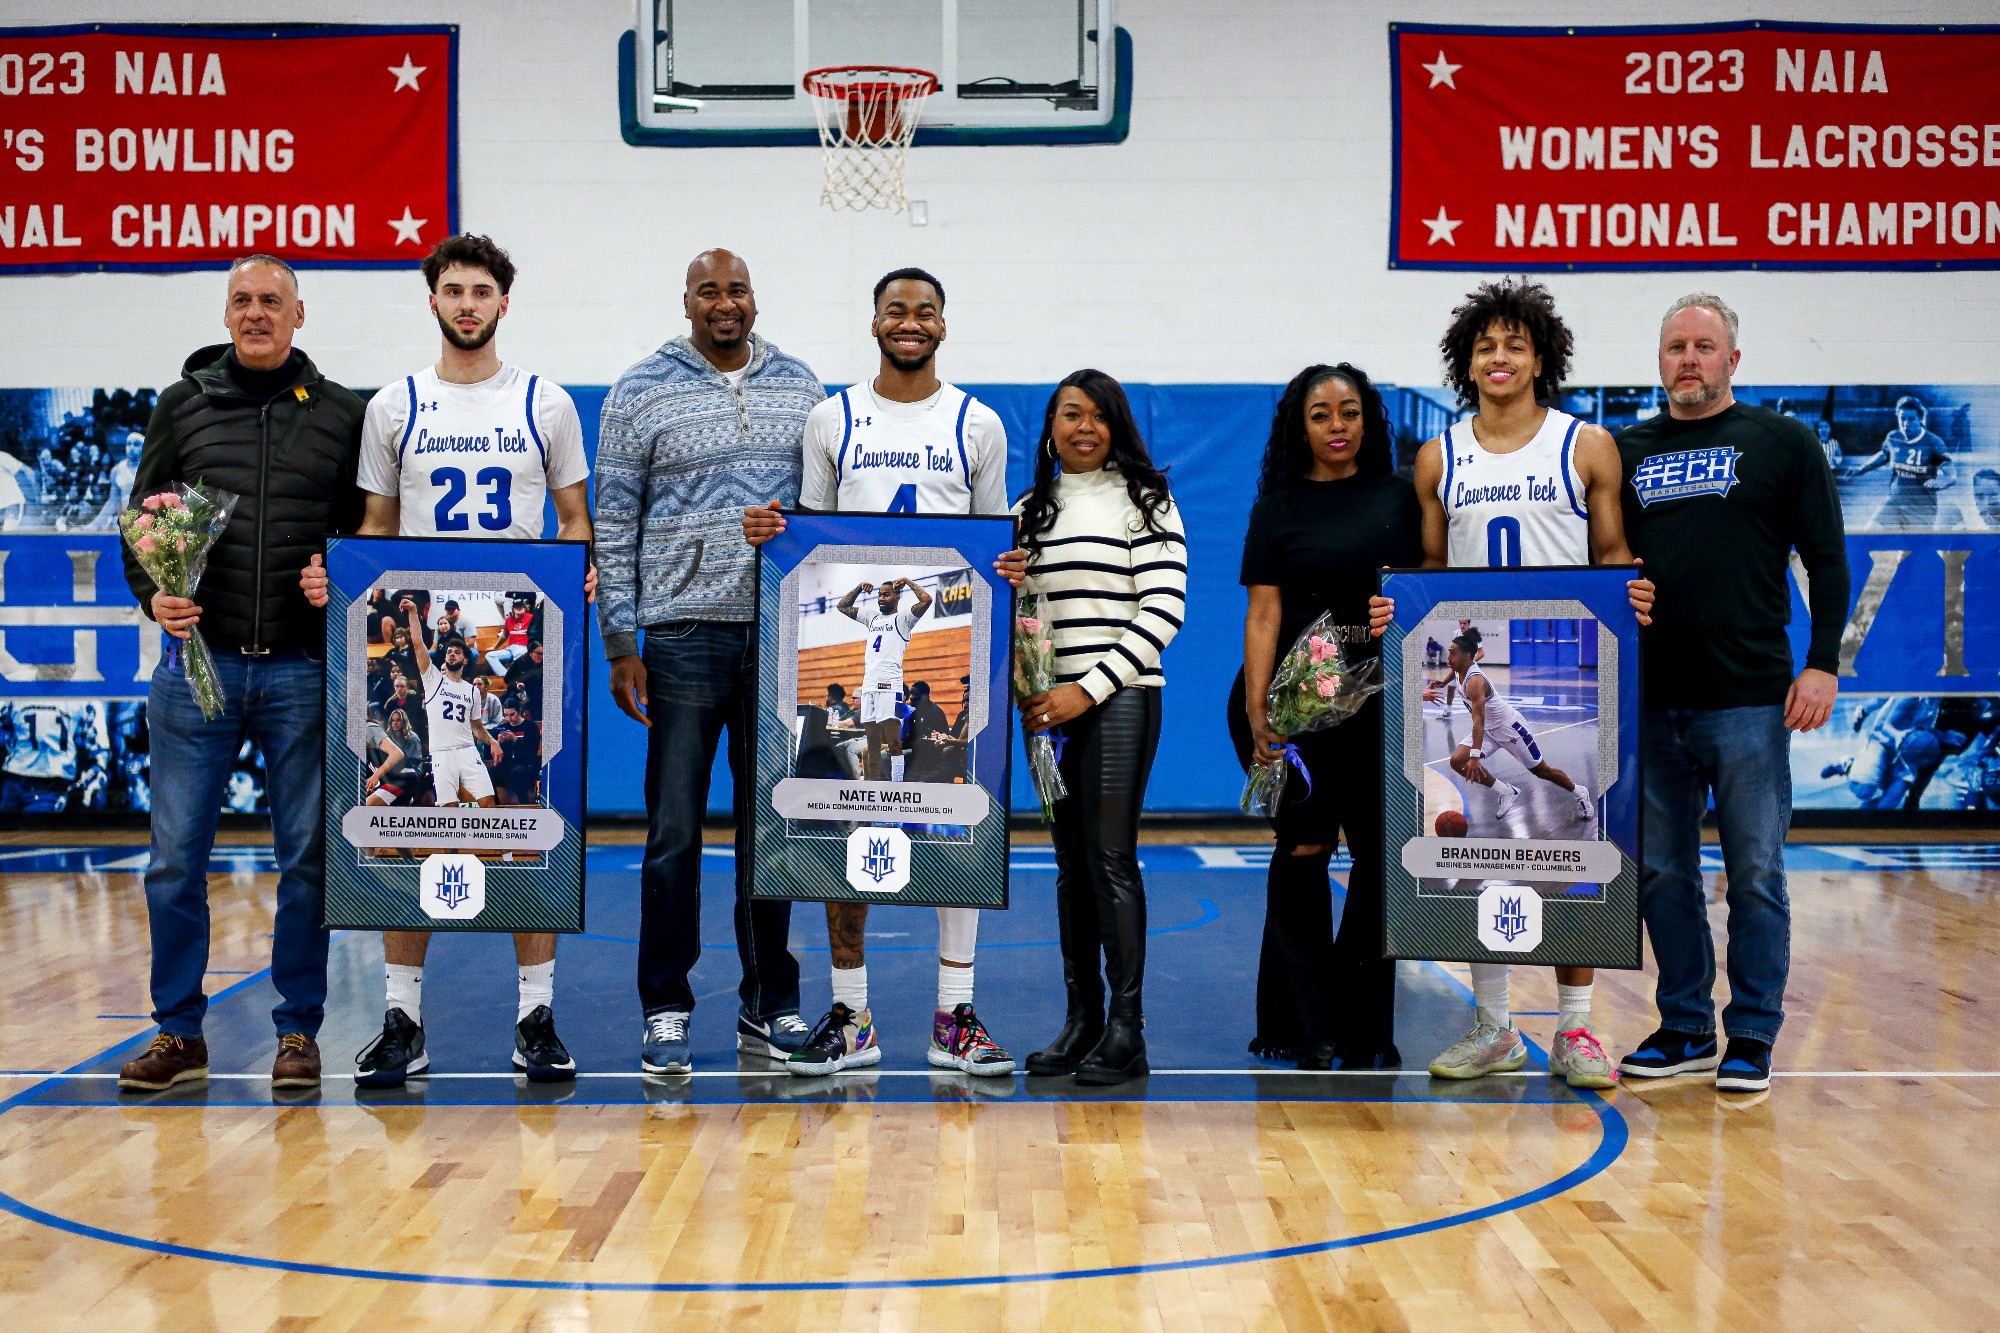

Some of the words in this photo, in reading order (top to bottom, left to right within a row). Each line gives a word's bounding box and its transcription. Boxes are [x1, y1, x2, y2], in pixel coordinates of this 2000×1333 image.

[116, 51, 225, 95] NAIA
[1626, 49, 1744, 93] 2023
[1776, 49, 1888, 92] NAIA
[76, 128, 293, 172] BOWLING
[1500, 126, 1718, 170] WOMEN'S
[1751, 125, 2000, 168] LACROSSE
[112, 204, 354, 247] CHAMPION
[1496, 203, 1737, 247] NATIONAL
[1768, 202, 2000, 245] CHAMPION
[416, 429, 488, 454] Lawrence
[496, 428, 526, 452] Tech
[852, 444, 918, 470] Lawrence
[926, 445, 953, 471] Tech
[1648, 450, 1729, 465] LAWRENCE
[1906, 448, 1922, 466] 21
[1635, 456, 1732, 487] TECH
[431, 466, 512, 532] 23
[1456, 482, 1519, 508] Lawrence
[1527, 476, 1556, 501] Tech
[1650, 482, 1717, 496] BASKETBALL
[872, 635, 882, 652] 4
[442, 700, 466, 723] 23
[807, 802, 831, 810] MEDIA
[832, 803, 893, 812] COMMUNICATION
[899, 806, 941, 814] COLUMBUS,
[839, 789, 876, 802] NATE
[879, 790, 922, 804] WARD
[370, 816, 457, 829] ALEJANDRO
[461, 818, 537, 831] GONZALEZ
[379, 830, 403, 838] MEDIA
[404, 831, 466, 839] COMMUNICATION
[473, 832, 504, 840] MADRID,
[505, 832, 528, 840] SPAIN
[1436, 861, 1472, 869] BUSINESS
[1473, 862, 1525, 870] MANAGEMENT
[1531, 864, 1574, 873] COLUMBUS,
[1575, 864, 1587, 872] OH
[1441, 847, 1511, 860] BRANDON
[1515, 849, 1581, 863] BEAVERS
